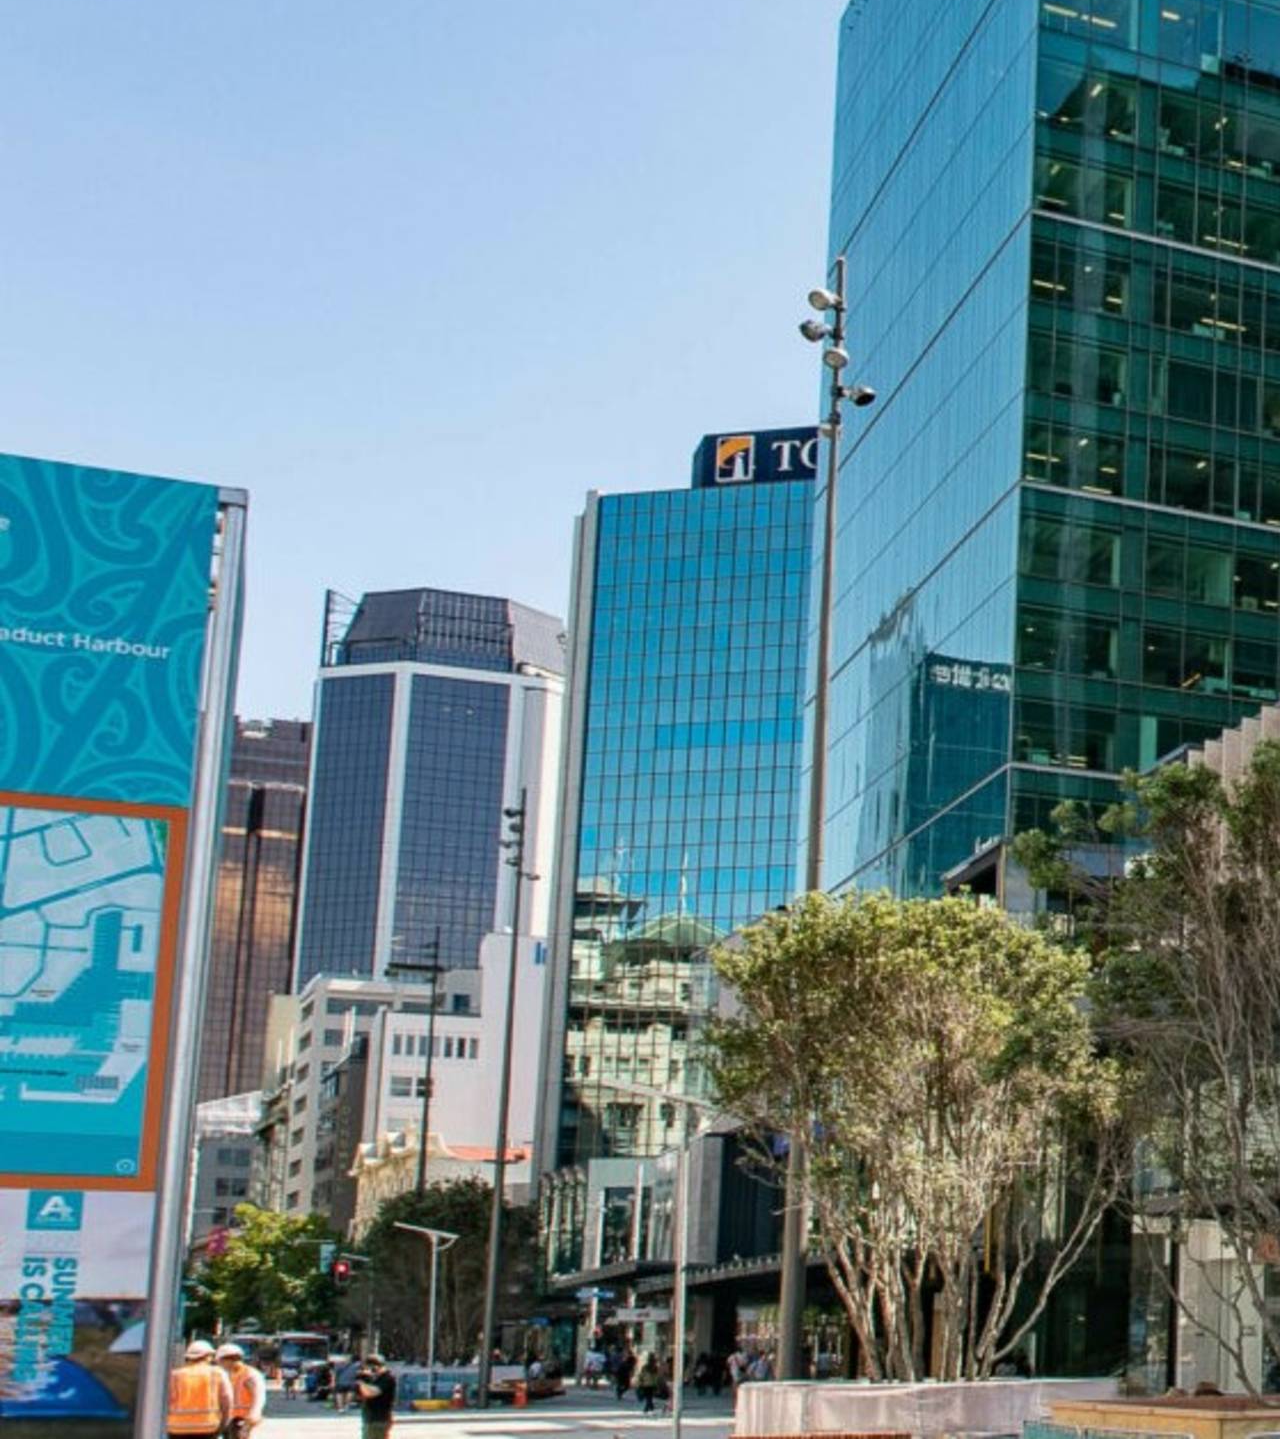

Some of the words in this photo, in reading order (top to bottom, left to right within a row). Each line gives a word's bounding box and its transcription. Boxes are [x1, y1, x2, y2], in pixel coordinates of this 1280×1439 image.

[73, 633, 171, 659] Harbour
[22, 1257, 48, 1277] IS
[11, 1283, 45, 1382] CALLING
[47, 1258, 77, 1355] SUMMER
